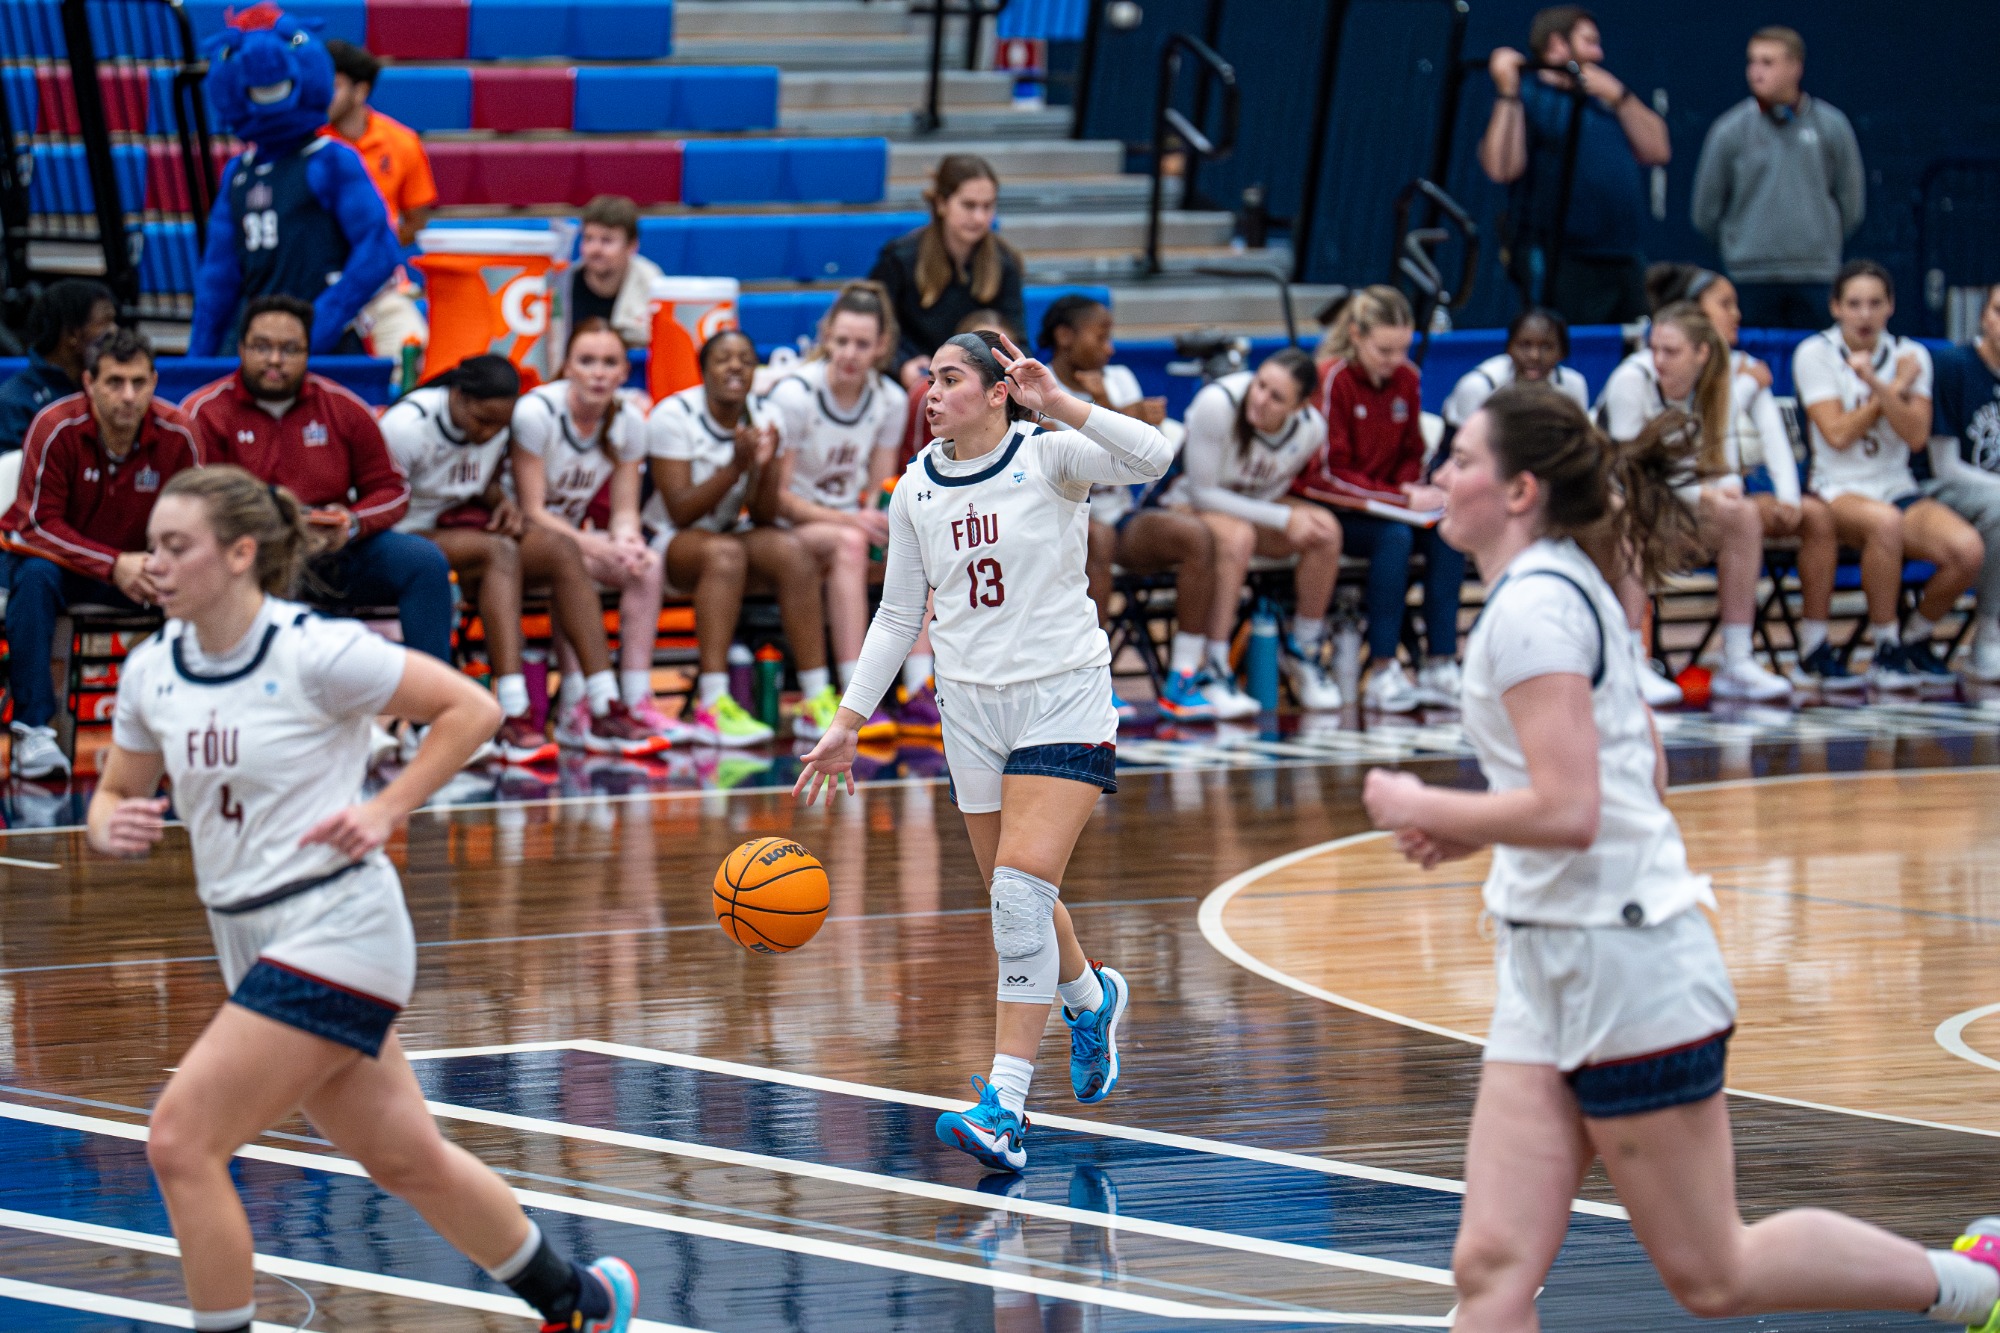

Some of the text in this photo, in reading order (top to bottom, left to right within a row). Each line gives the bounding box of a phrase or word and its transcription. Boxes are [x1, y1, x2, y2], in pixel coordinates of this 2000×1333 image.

[502, 275, 547, 336] G
[951, 512, 999, 551] FDU
[966, 557, 1005, 610] 13
[187, 724, 239, 768] FDU
[220, 783, 244, 836] 4
